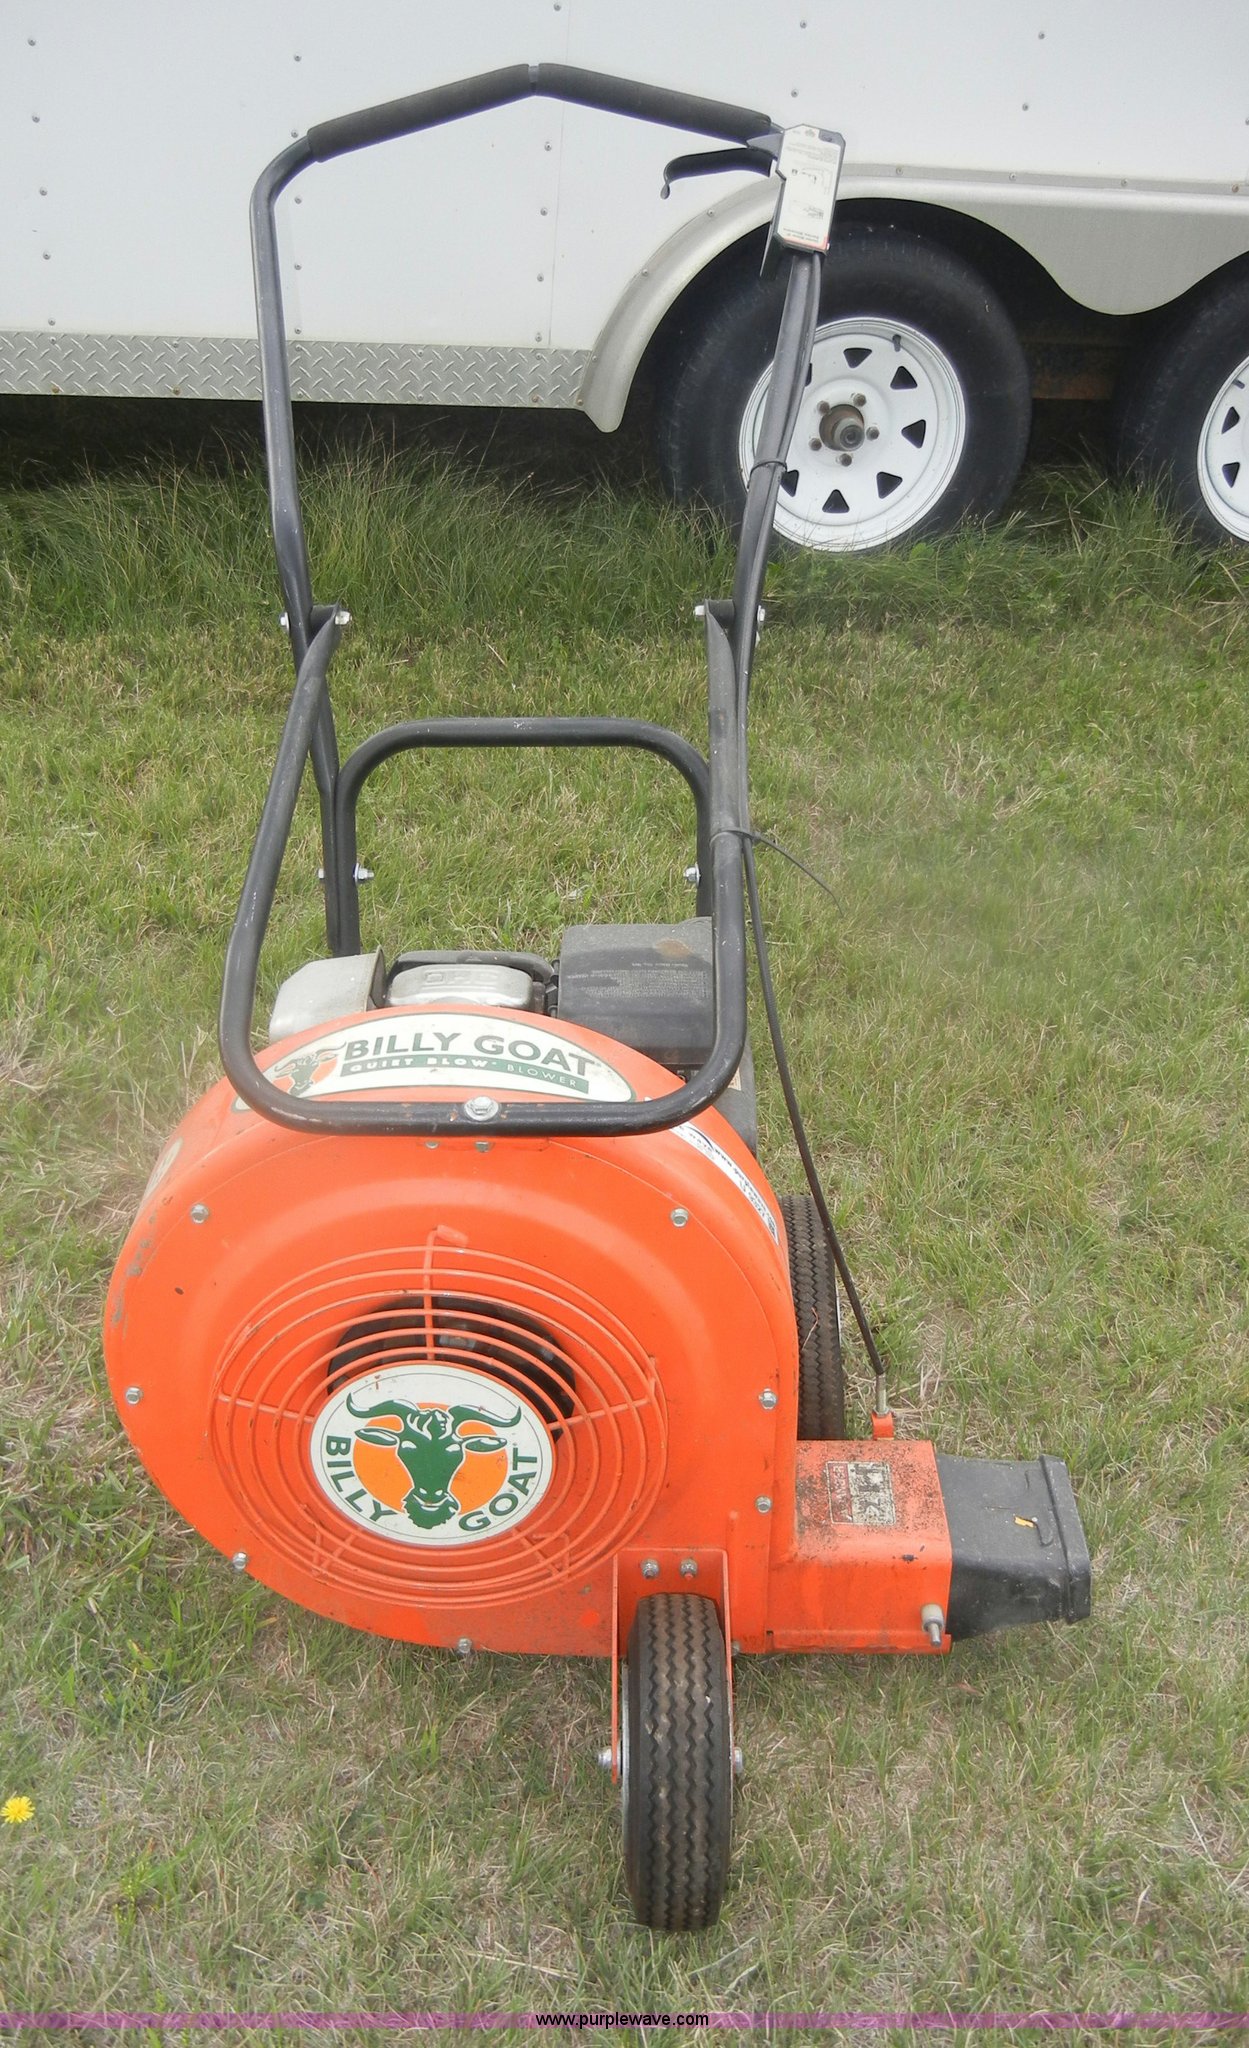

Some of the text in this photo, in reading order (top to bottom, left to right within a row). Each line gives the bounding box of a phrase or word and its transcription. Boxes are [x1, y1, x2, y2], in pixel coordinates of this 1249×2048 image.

[344, 1032, 595, 1077] BILLY GOAT
[349, 1057, 577, 1088] QUIET BLOW BLOWER
[325, 1434, 538, 1532] BILLY GOAT
